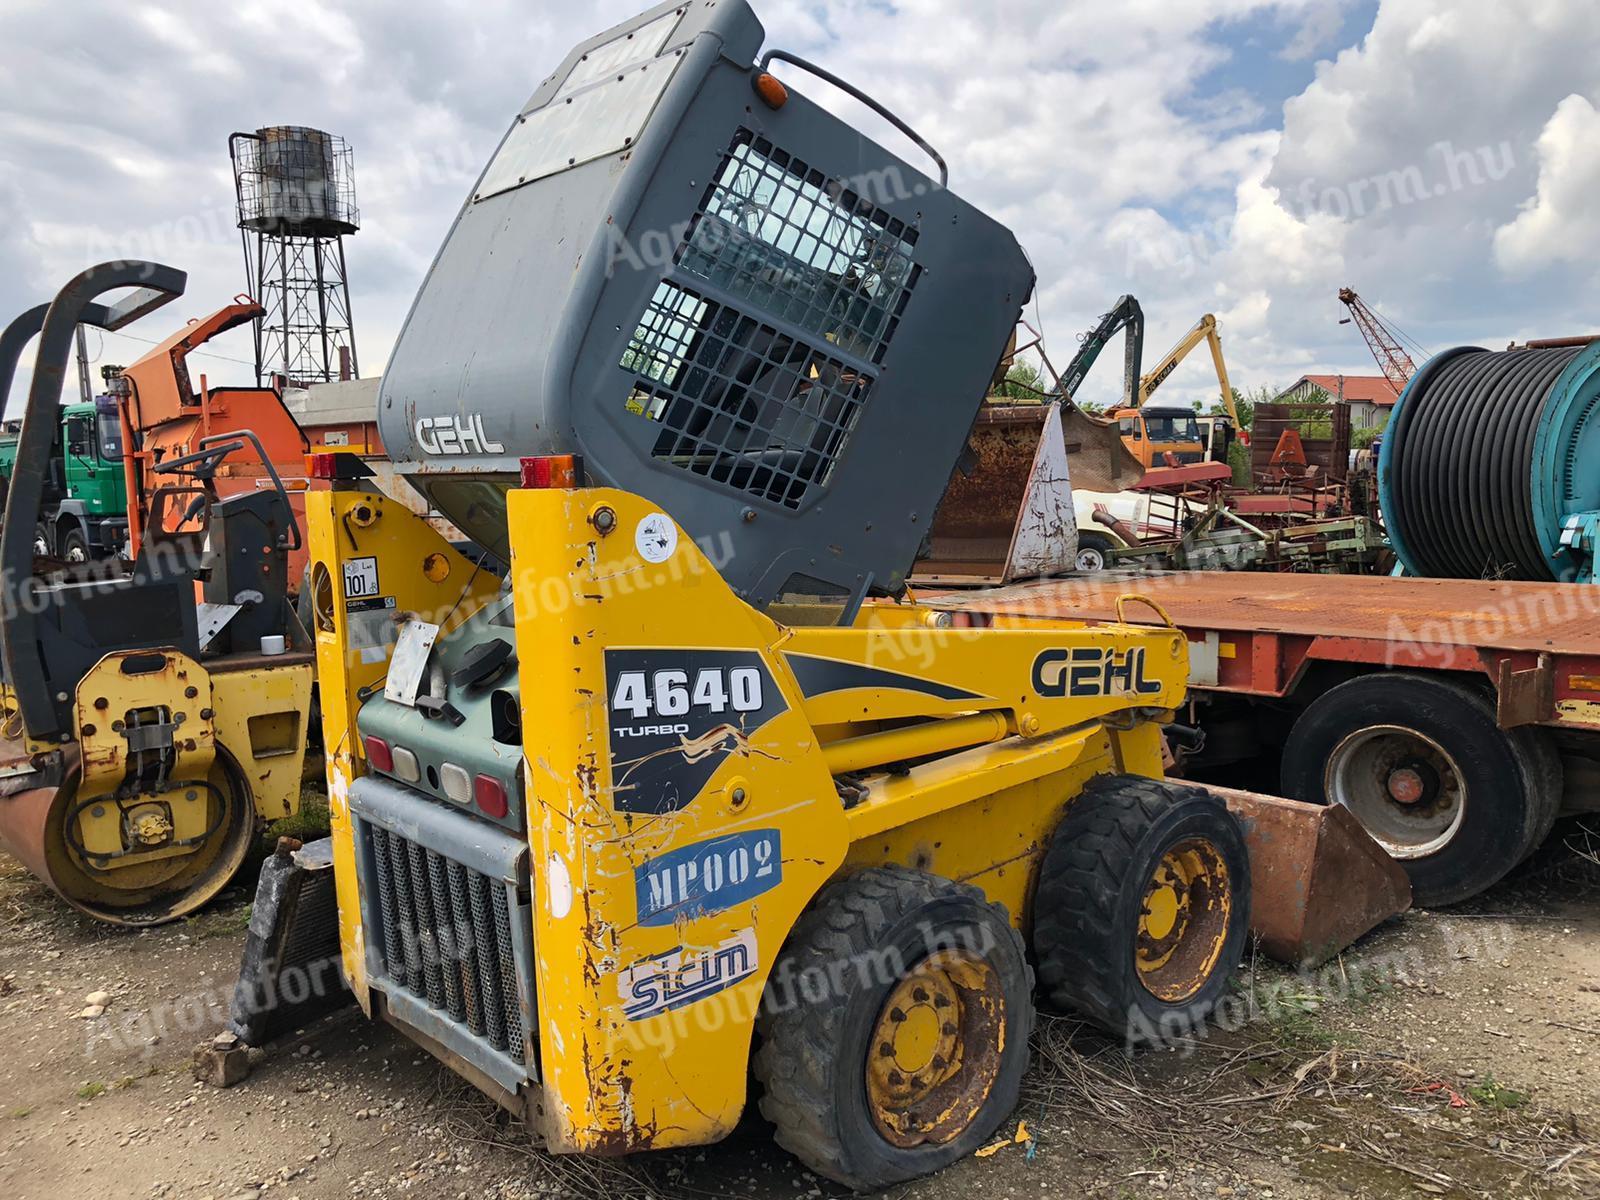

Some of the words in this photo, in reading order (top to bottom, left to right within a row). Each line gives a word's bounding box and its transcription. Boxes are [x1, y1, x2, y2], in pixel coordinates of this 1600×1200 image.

[415, 414, 504, 455] GEHL
[347, 575, 366, 595] 101
[1031, 647, 1162, 697] GEHL
[612, 668, 763, 719] 4640
[614, 724, 689, 737] TURBO
